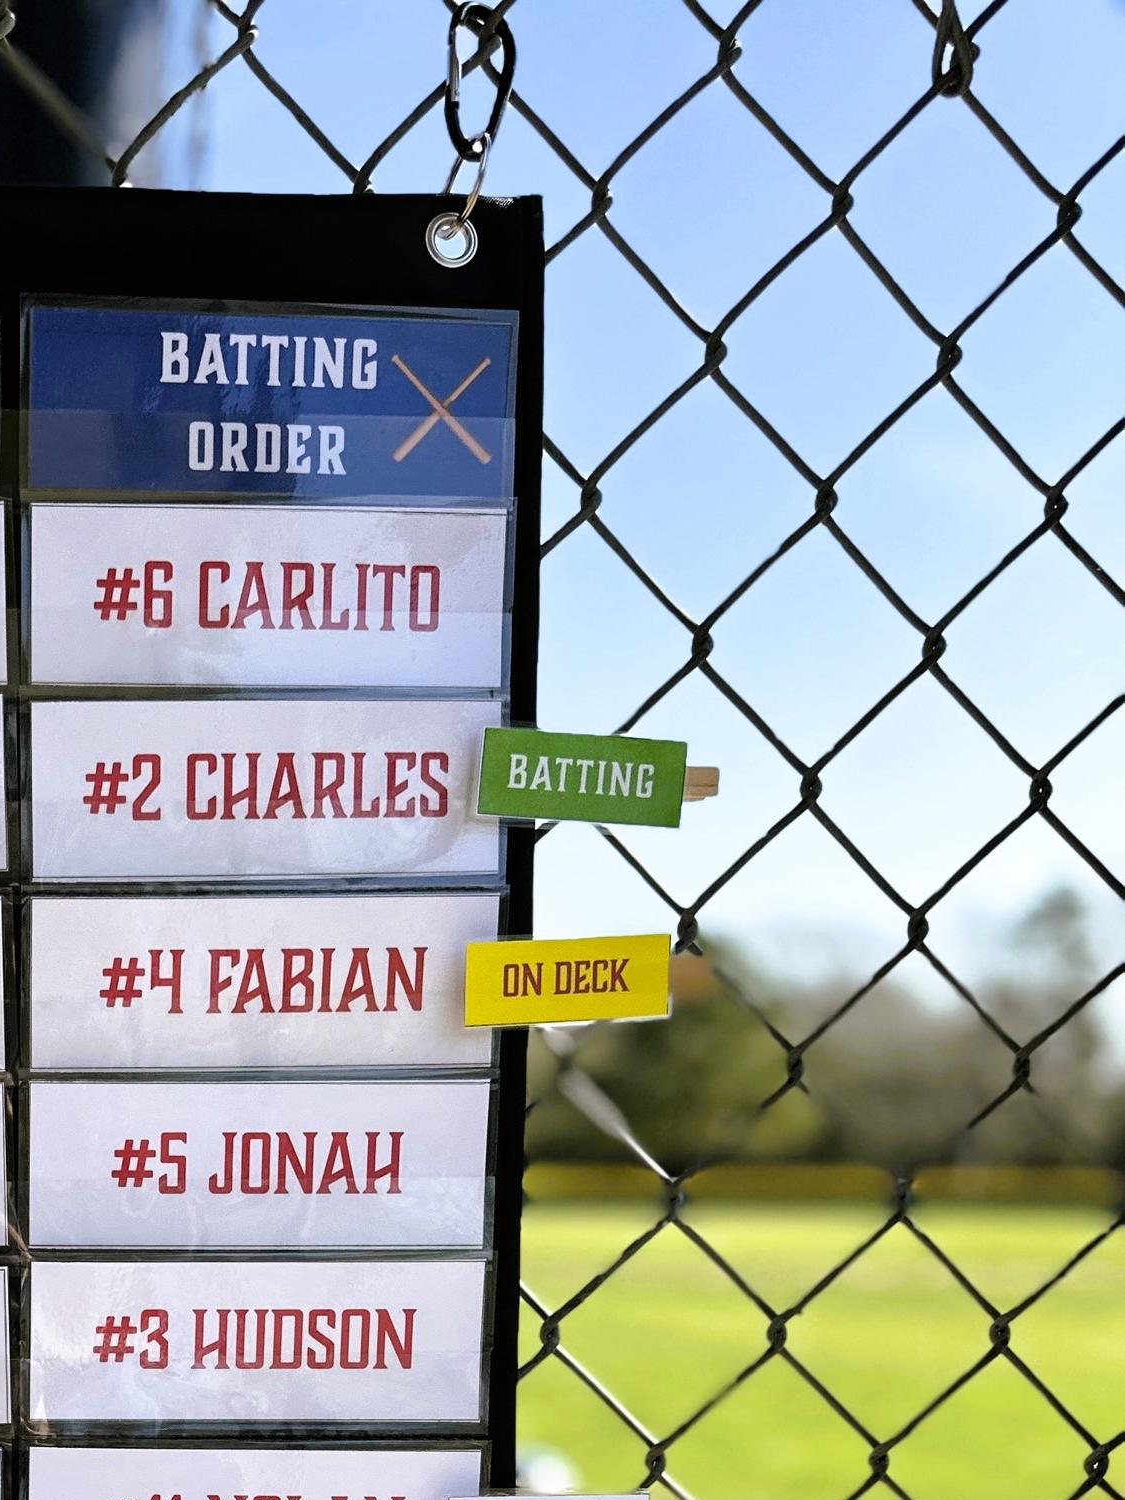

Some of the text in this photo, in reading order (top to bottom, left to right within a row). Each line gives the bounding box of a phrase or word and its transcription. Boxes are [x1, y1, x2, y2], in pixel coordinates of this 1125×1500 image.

[159, 331, 378, 389] BATTING
[188, 421, 347, 475] ORDER
[93, 560, 441, 631] #6 CARLITO
[82, 751, 450, 820] #2 CHARLES
[507, 753, 655, 798] BATTING
[99, 947, 427, 1014] #4 FABIAN
[502, 958, 630, 997] ON DECK
[110, 1131, 404, 1194] #5 JONAH
[92, 1308, 418, 1369] #3 HUDSON
